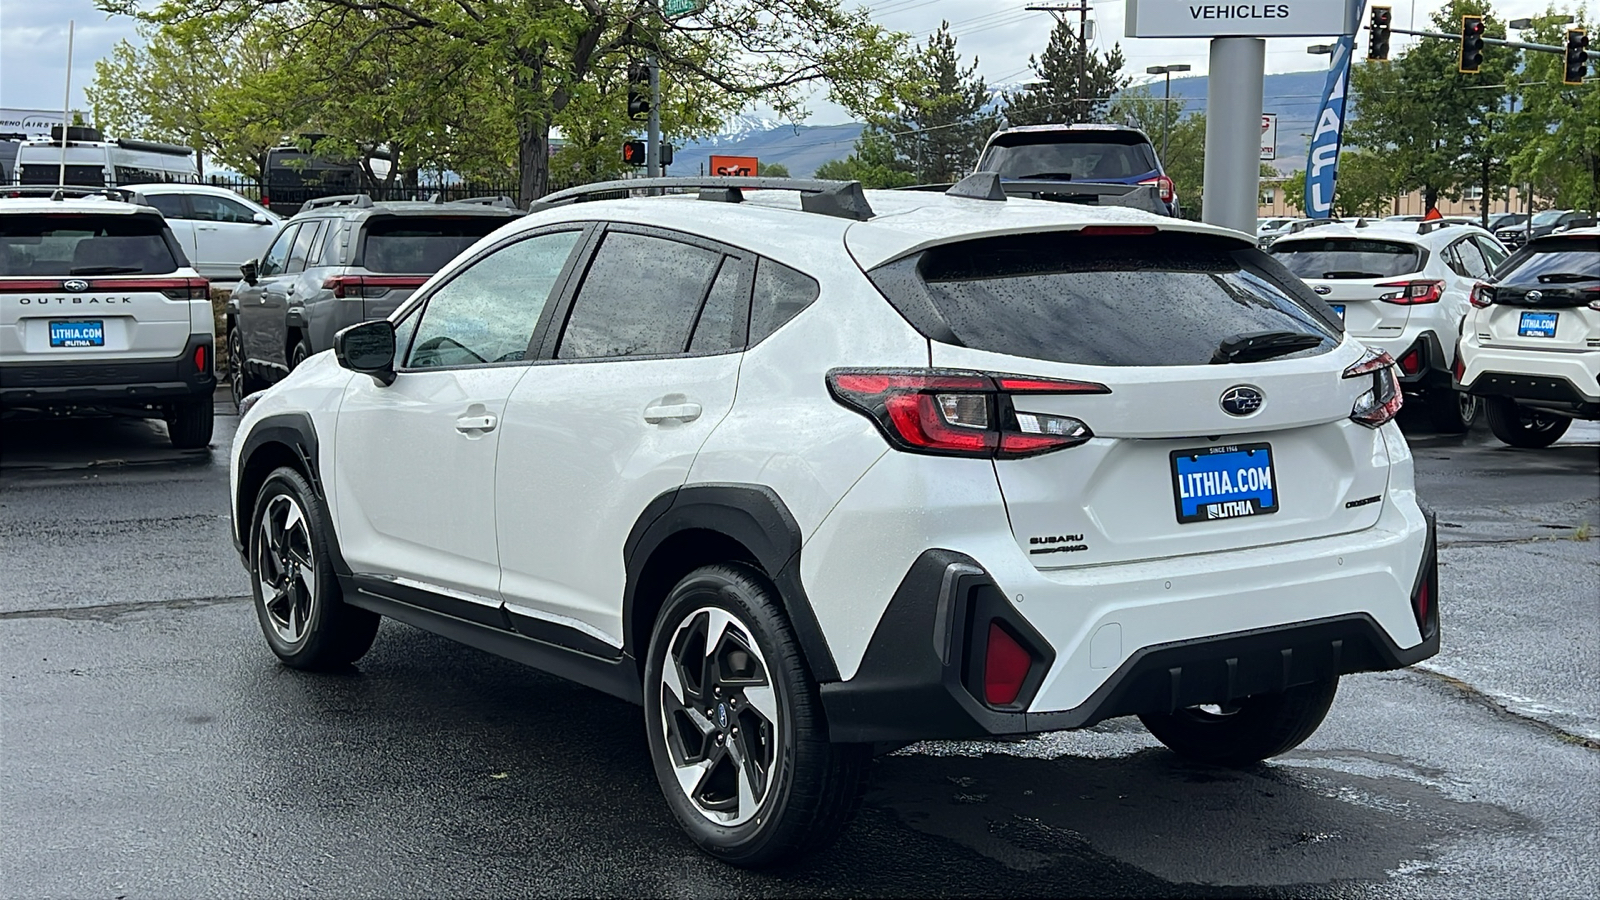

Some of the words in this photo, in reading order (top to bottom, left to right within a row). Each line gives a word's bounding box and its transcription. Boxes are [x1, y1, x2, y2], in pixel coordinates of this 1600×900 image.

[1189, 5, 1289, 19] VEHICLES
[19, 297, 132, 305] OUTBACK
[1520, 319, 1555, 330] LITHIA.COM
[51, 328, 102, 339] LITHIA.COM
[1209, 446, 1226, 455] SINCE
[1178, 466, 1272, 499] LITHIA.COM
[1217, 500, 1255, 518] LITHIA
[1029, 533, 1084, 545] SUBARU
